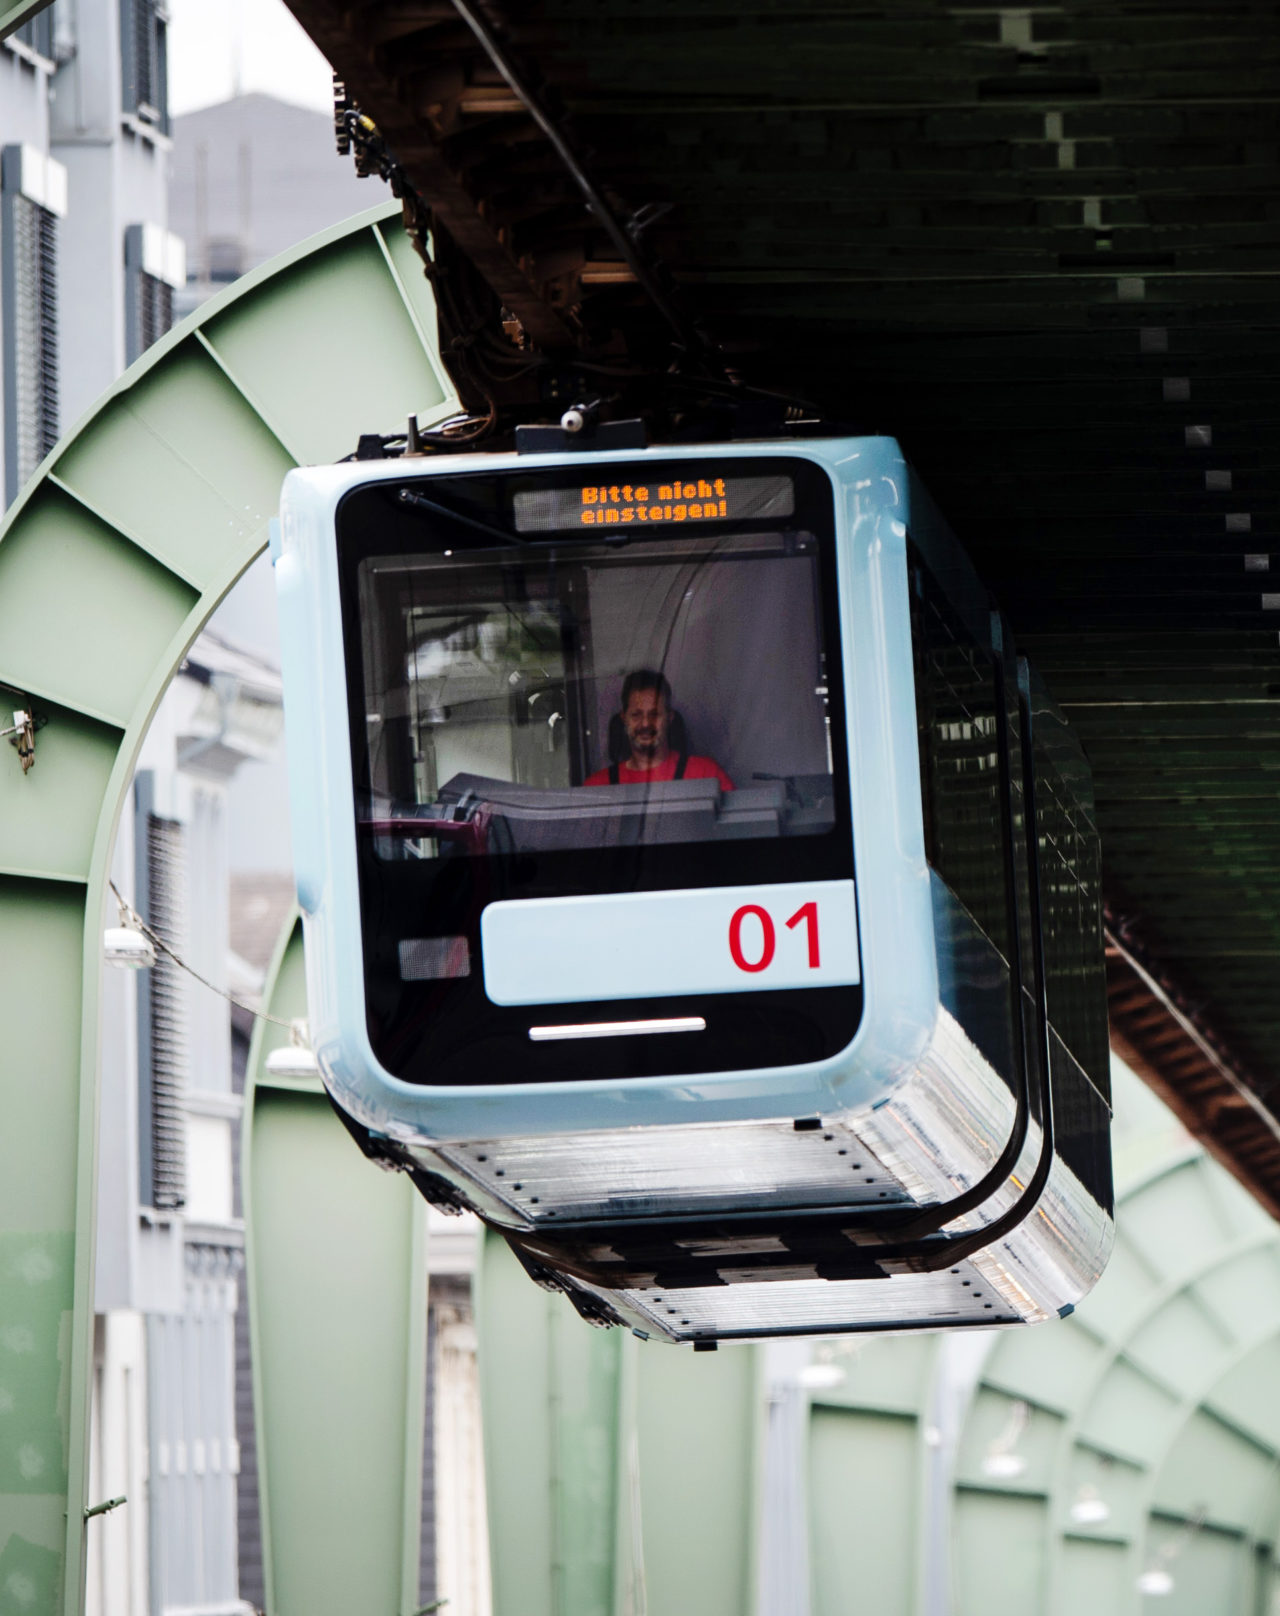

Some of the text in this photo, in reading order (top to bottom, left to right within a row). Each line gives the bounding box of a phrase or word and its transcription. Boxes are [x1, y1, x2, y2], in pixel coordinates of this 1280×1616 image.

[582, 478, 725, 504] Bitte nicht
[581, 500, 727, 524] einsteigen!
[728, 901, 821, 973] 01
